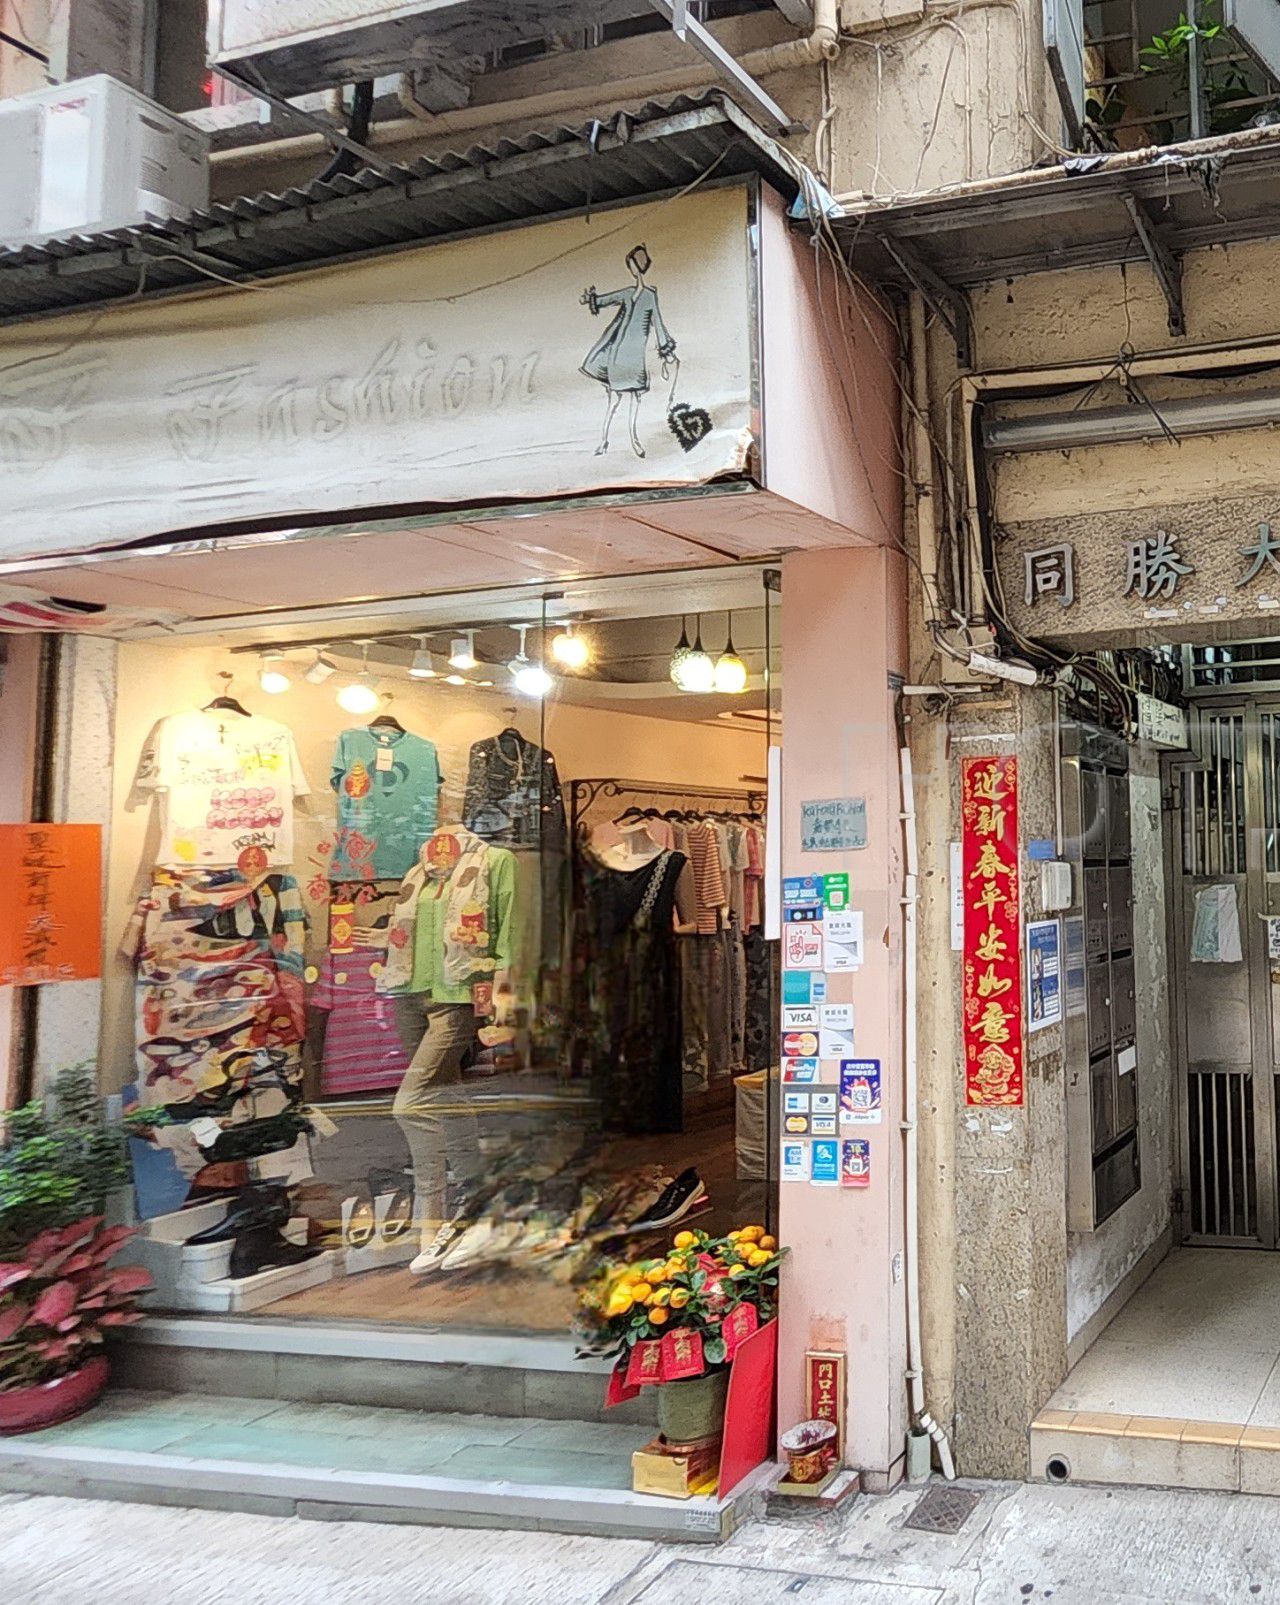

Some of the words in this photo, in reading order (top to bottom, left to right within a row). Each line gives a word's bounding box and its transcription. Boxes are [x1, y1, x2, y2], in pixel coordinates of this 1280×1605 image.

[968, 764, 1015, 1044] 迎新春平安如意
[789, 1013, 812, 1022] VISA
